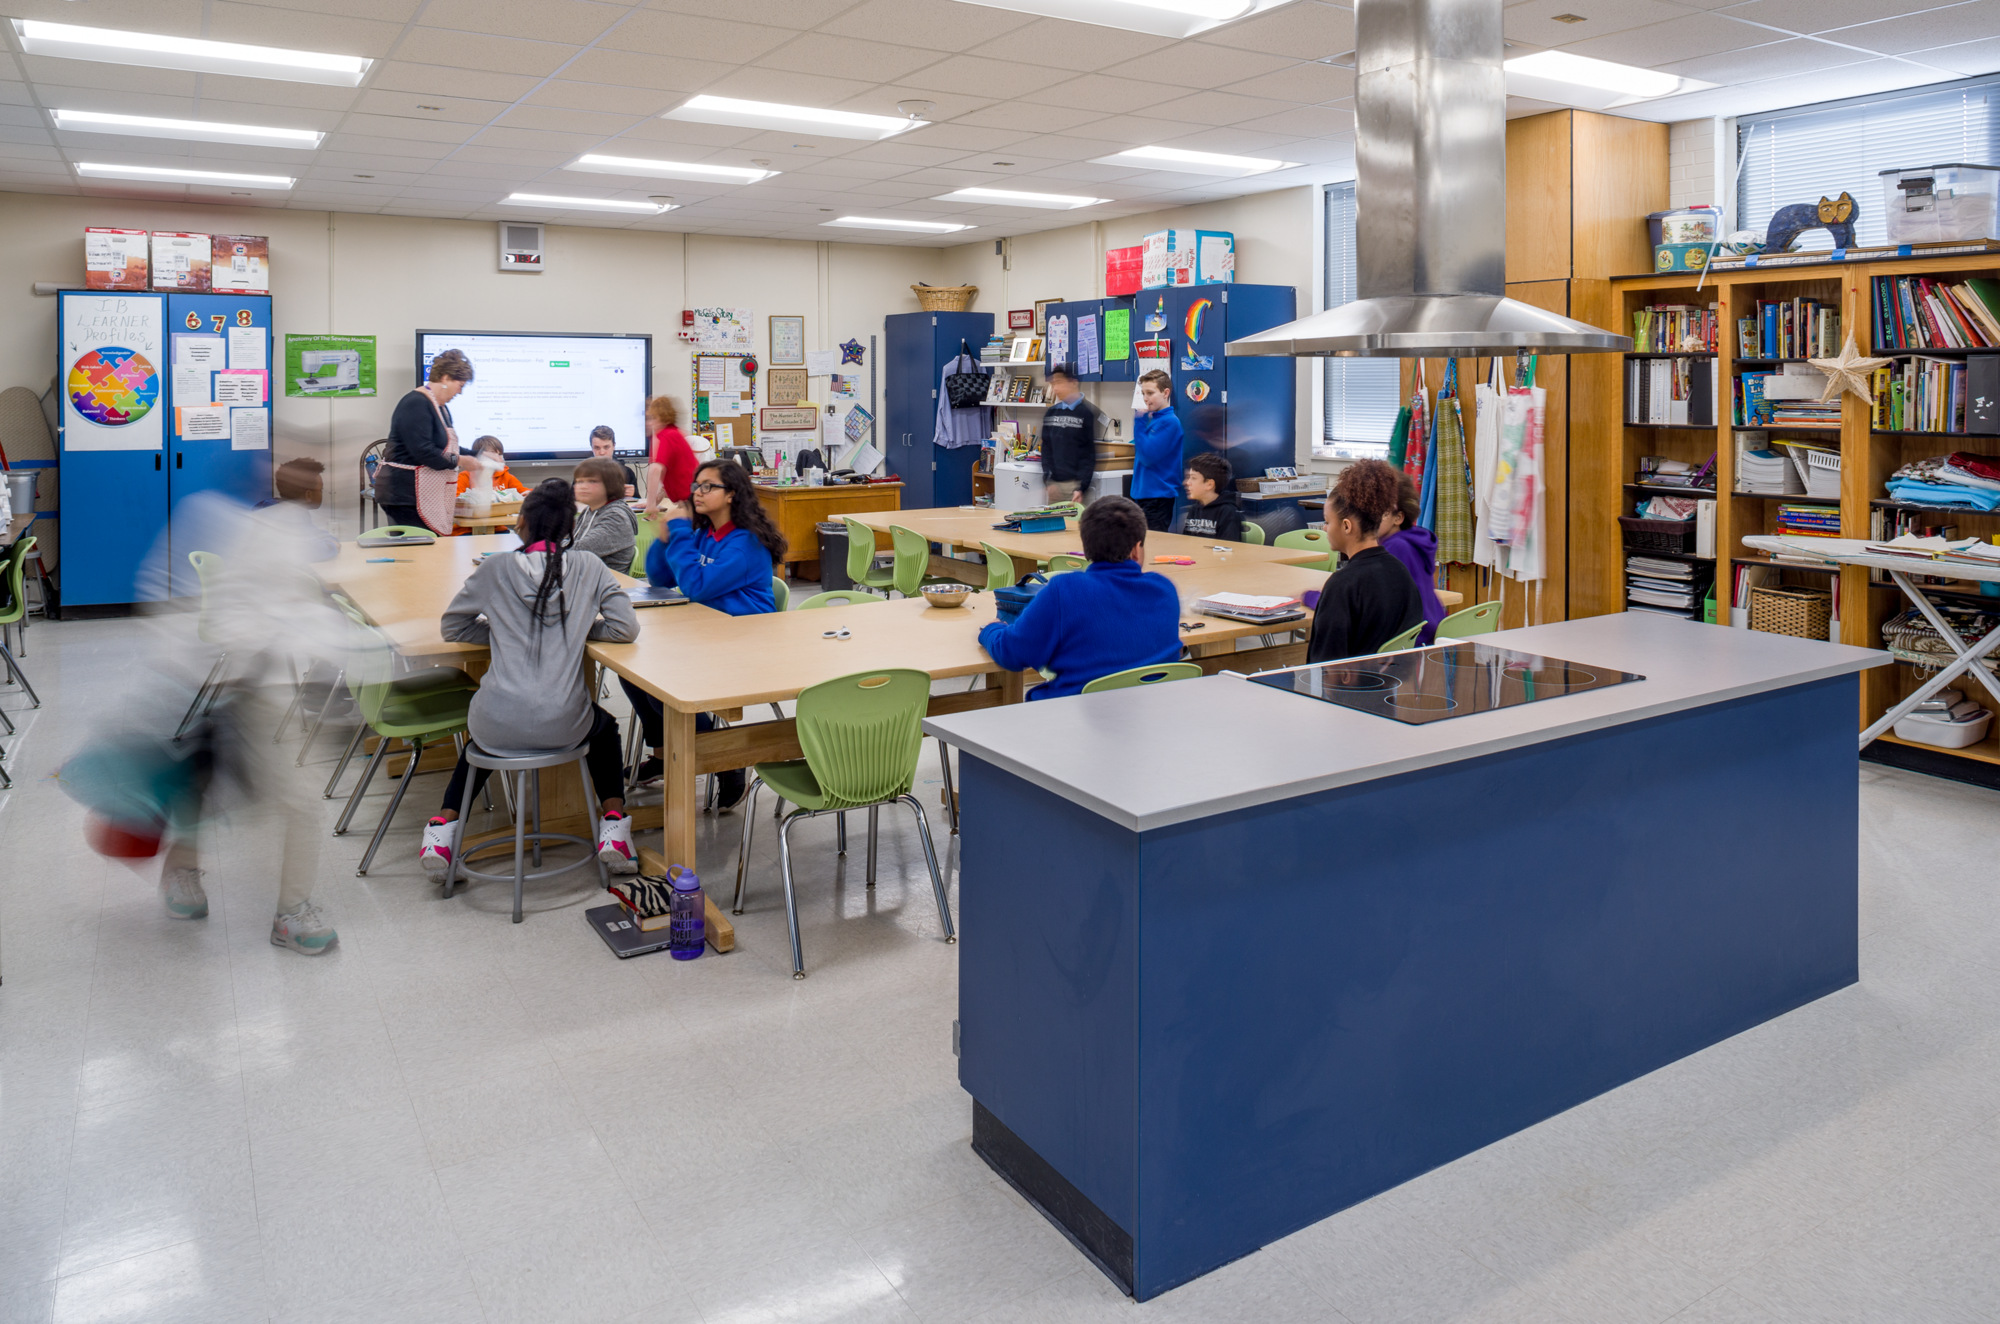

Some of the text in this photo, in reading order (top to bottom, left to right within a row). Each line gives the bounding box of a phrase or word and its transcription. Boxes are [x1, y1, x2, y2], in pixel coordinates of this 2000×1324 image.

[77, 314, 150, 328] LEARNER
[185, 311, 202, 330] 6
[211, 315, 227, 333] 7
[236, 309, 253, 327] 8
